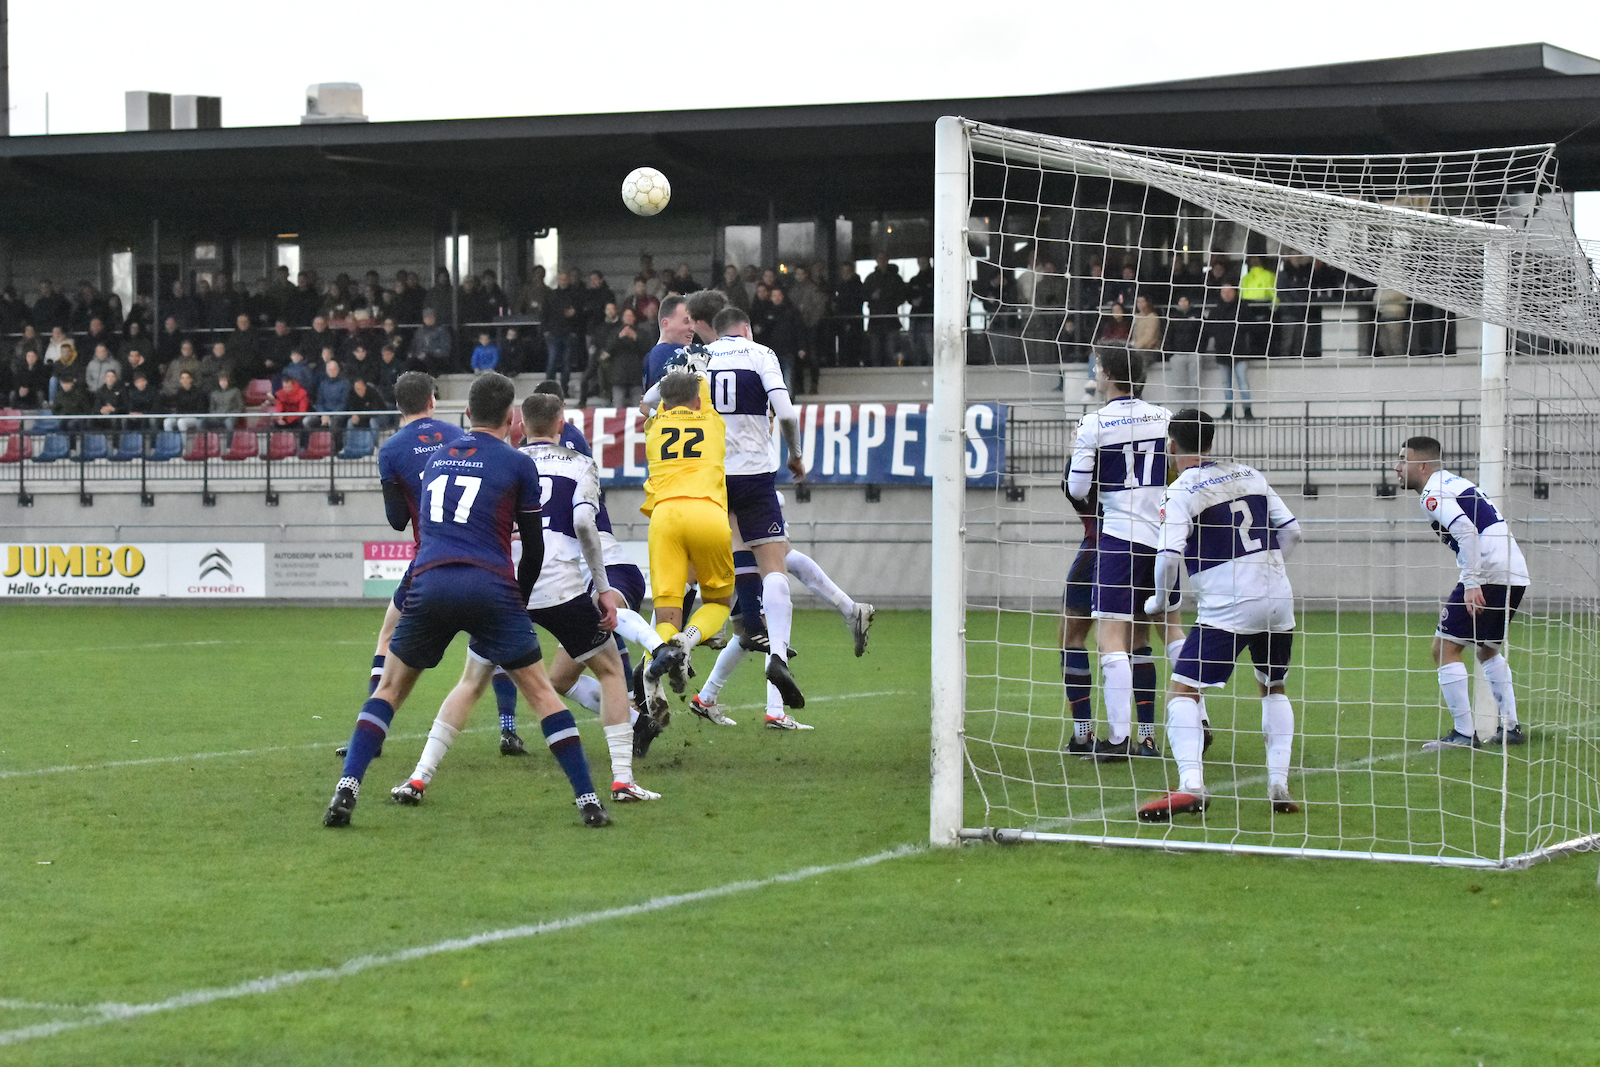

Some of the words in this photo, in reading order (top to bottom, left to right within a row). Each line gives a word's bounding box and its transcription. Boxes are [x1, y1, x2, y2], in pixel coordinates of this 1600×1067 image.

[660, 427, 705, 461] 22
[432, 459, 484, 469] Noordam
[1121, 439, 1157, 489] 17
[426, 473, 483, 524] 17
[1228, 499, 1263, 553] 2
[2, 545, 146, 578] JUMBO
[8, 582, 41, 595] Hallo
